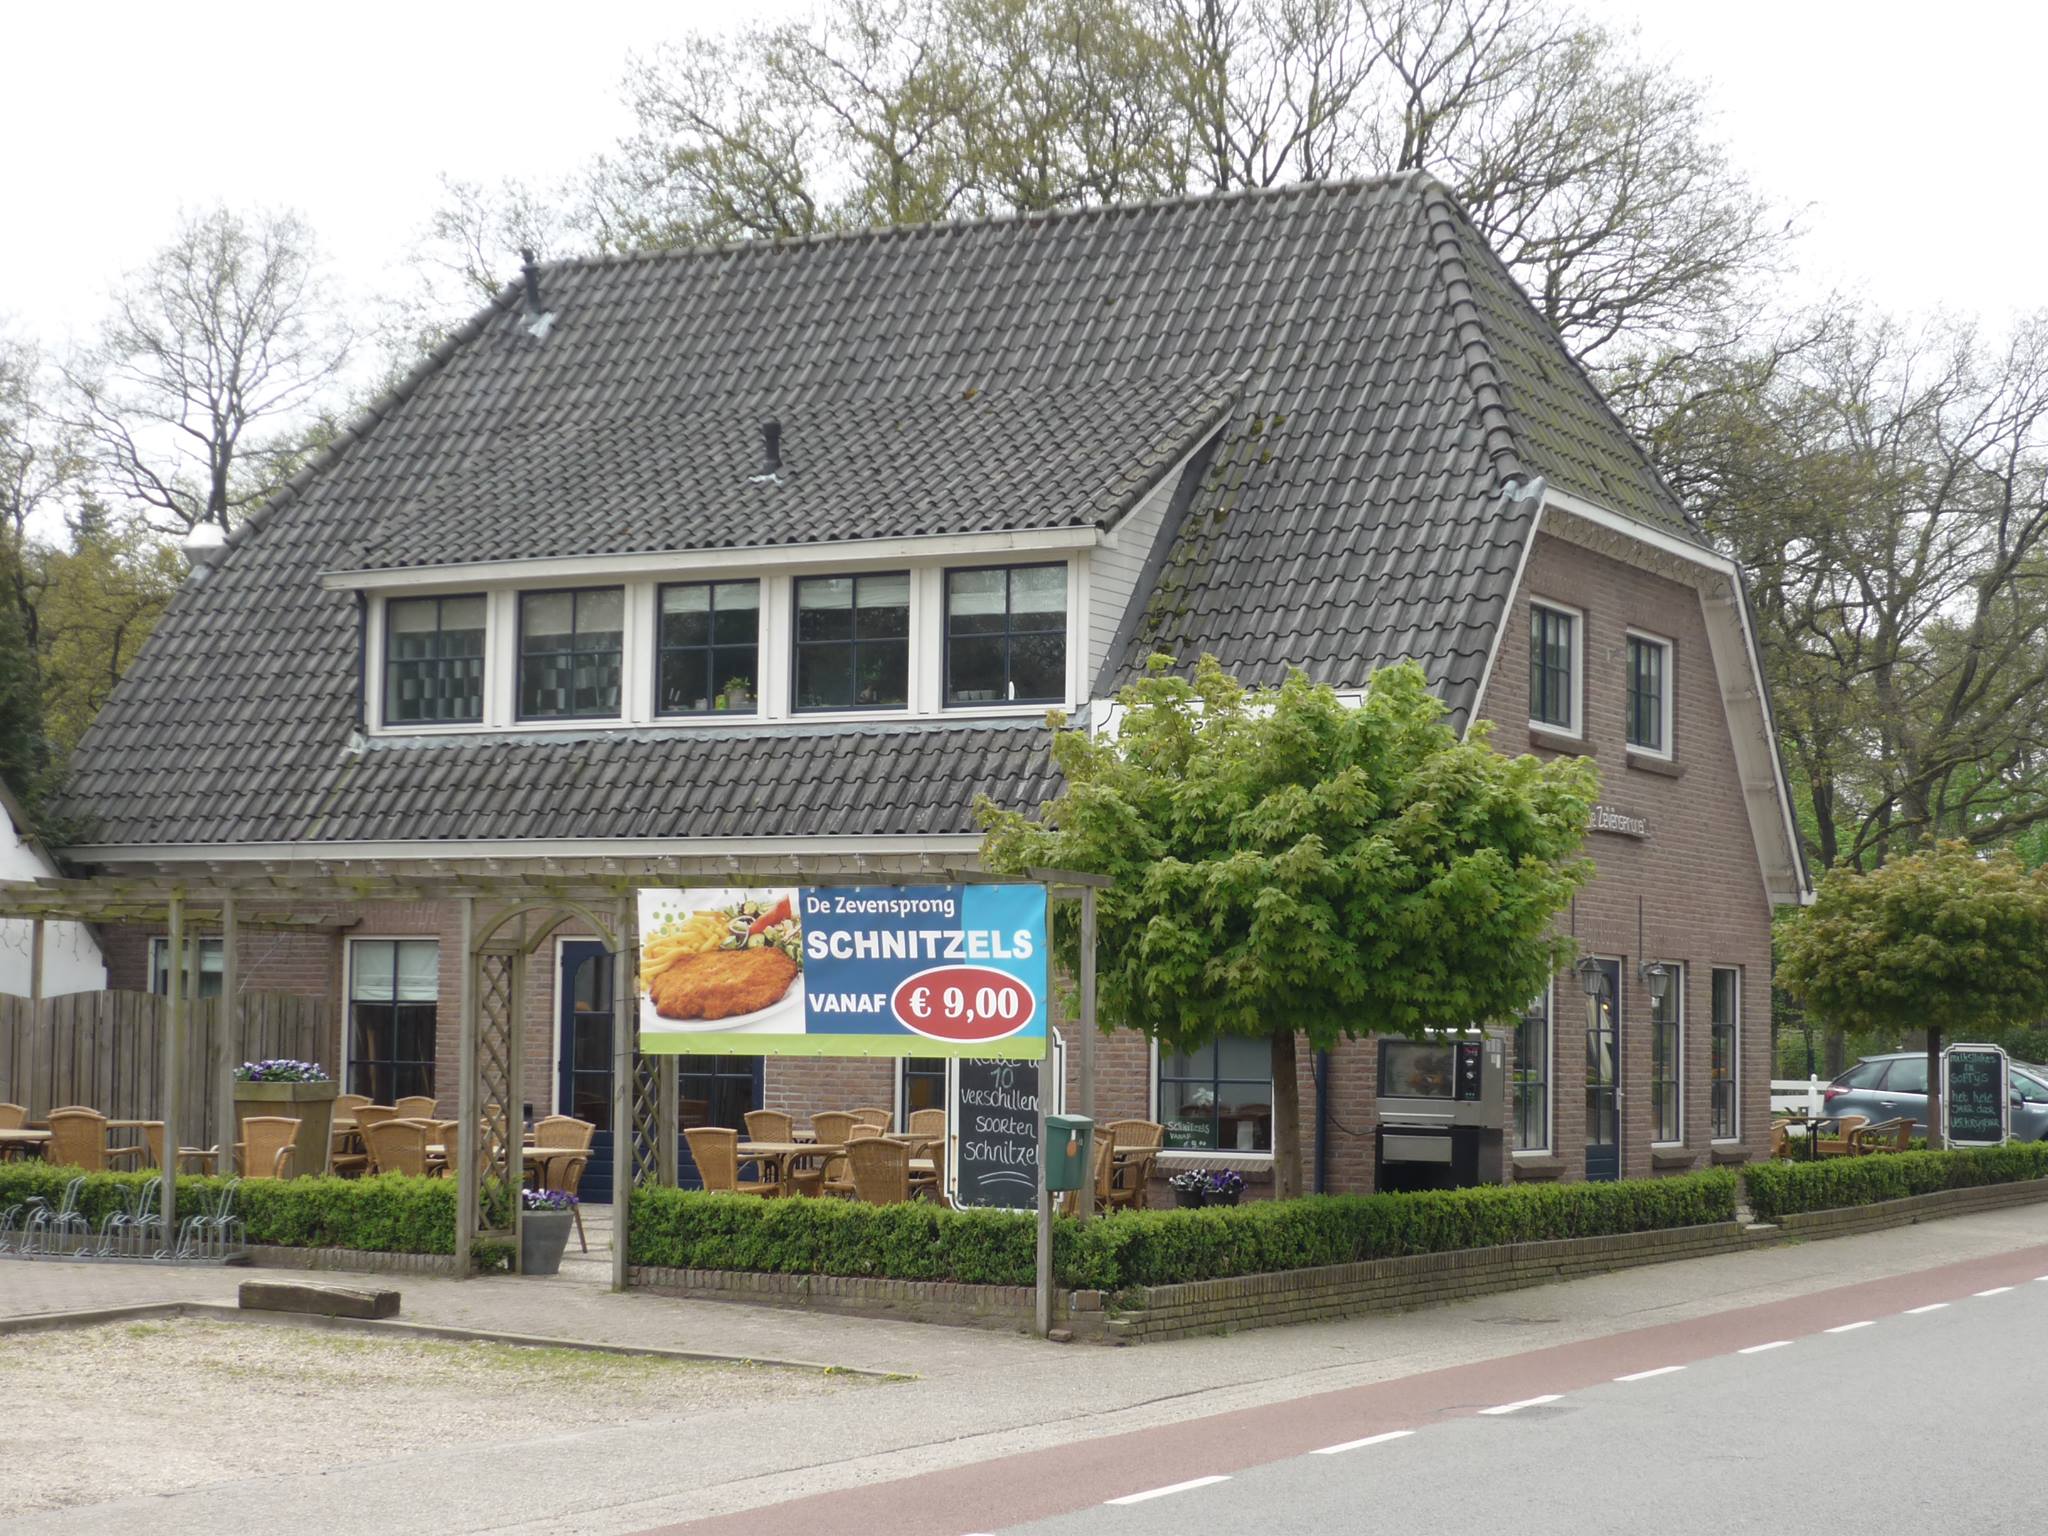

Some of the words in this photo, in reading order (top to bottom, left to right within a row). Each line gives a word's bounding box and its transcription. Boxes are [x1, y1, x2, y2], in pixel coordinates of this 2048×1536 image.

[807, 897, 830, 914] De
[835, 896, 955, 918] Zevensprong
[807, 929, 1033, 960] SCHNITZELS
[808, 993, 887, 1013] VANAF
[909, 986, 932, 1018] €
[943, 986, 1019, 1023] 9,00
[990, 1066, 1014, 1088] 10
